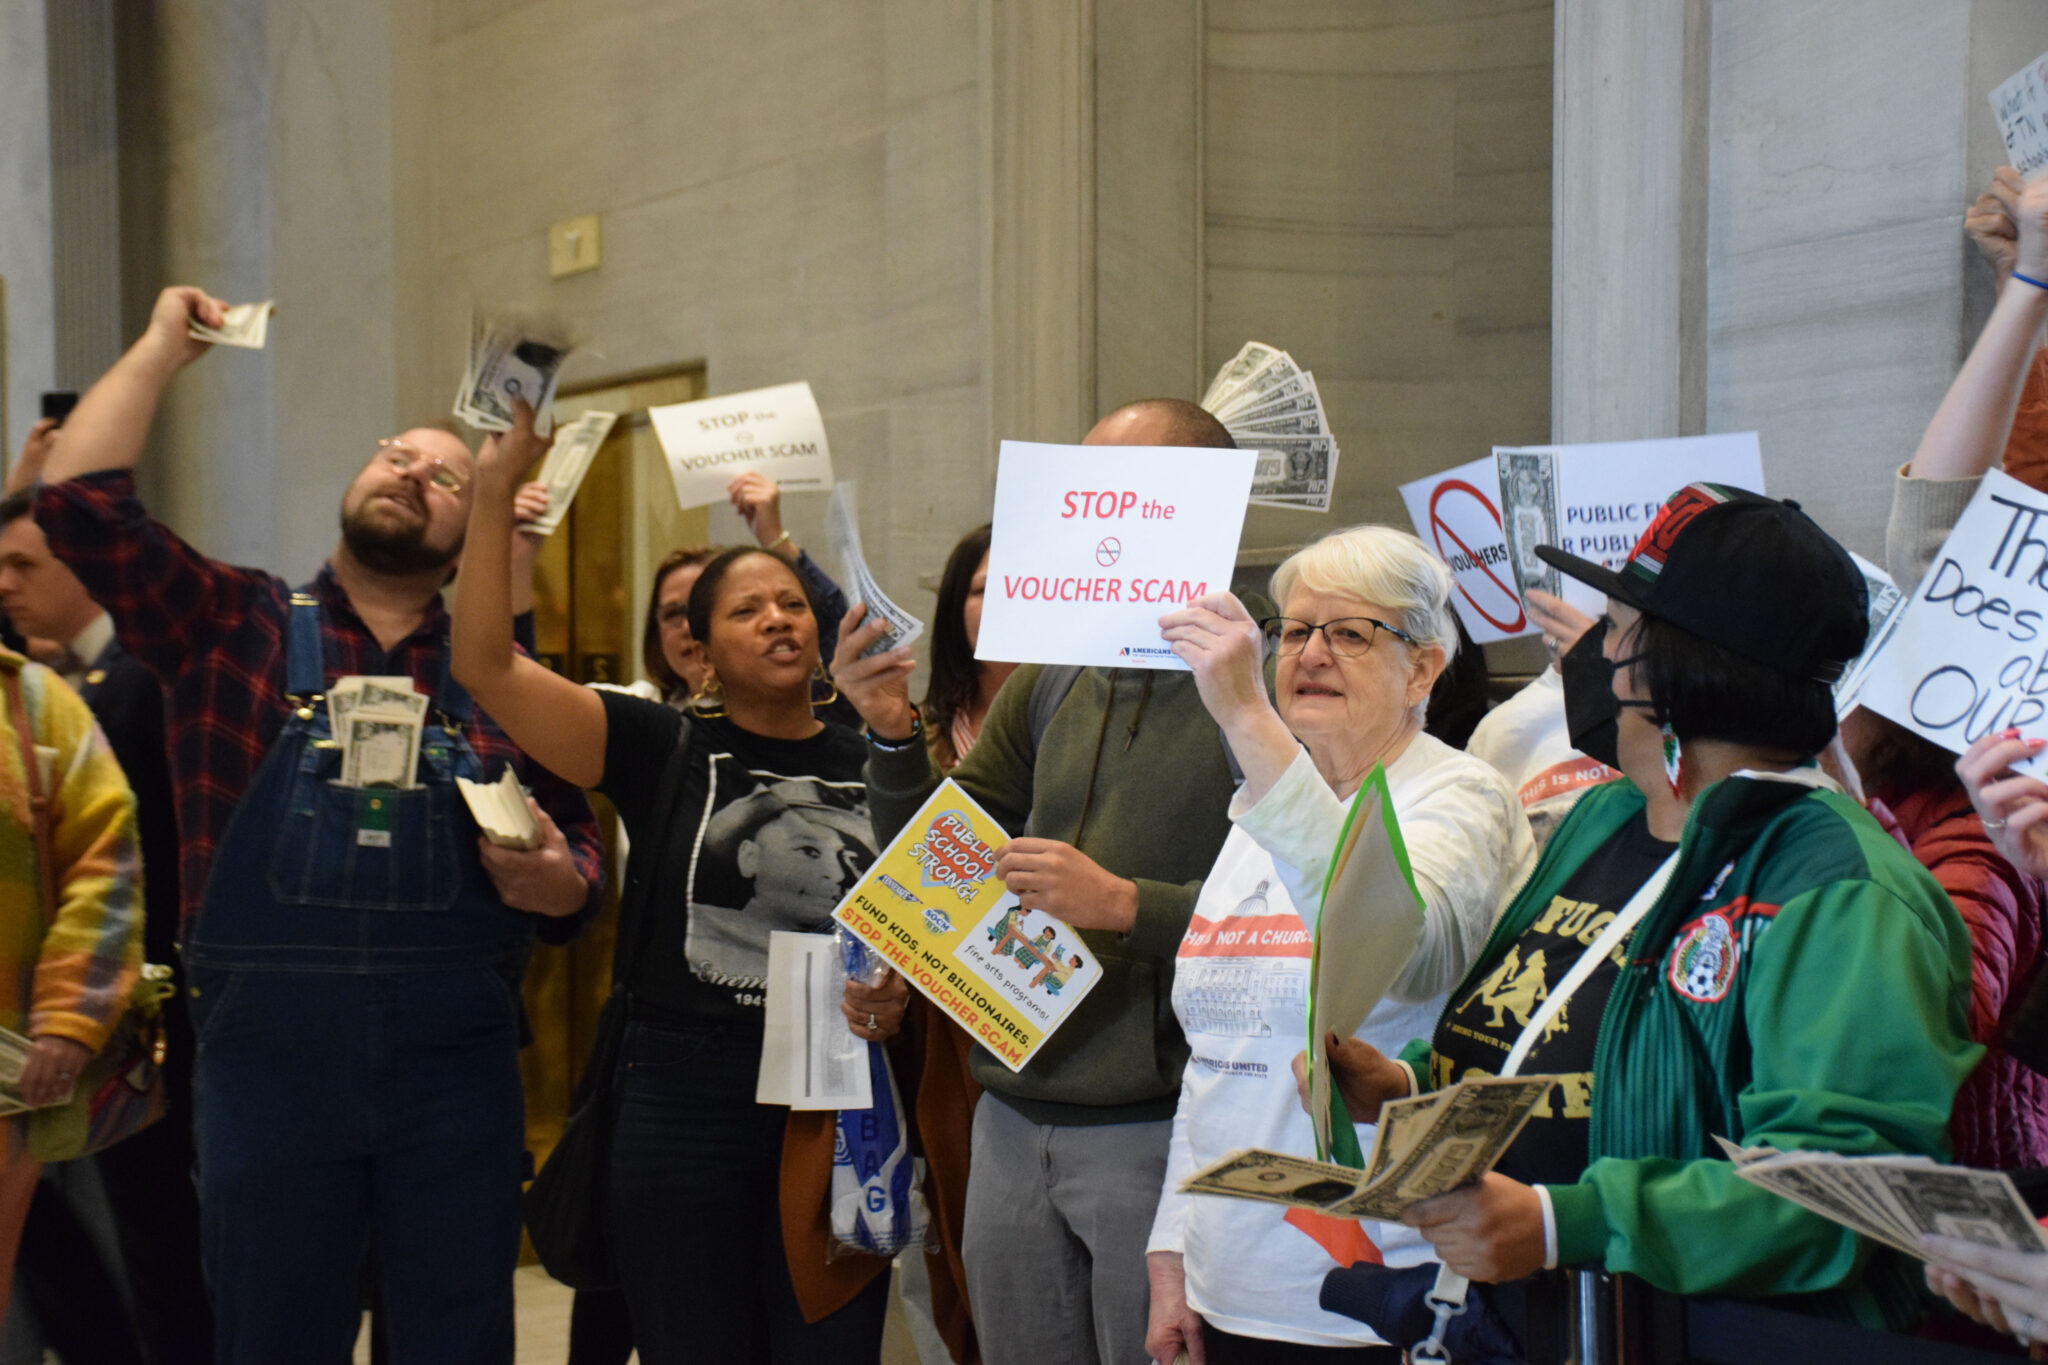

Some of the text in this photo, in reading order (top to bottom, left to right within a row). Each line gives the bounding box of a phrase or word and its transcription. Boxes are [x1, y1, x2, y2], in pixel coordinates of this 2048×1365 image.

[698, 411, 750, 432] STOP
[681, 442, 819, 471] VOUCHER SCAM
[1061, 491, 1175, 520] STOP the
[1567, 503, 1638, 524] PUBLIC
[1580, 534, 1639, 553] PUBLI
[1004, 575, 1207, 603] VOUCHER SCAM
[1924, 558, 2042, 642] Does
[1523, 764, 1610, 802] HIS IS NOT
[940, 815, 995, 864] PUBLIC
[925, 829, 985, 884] SCHOOL
[908, 843, 979, 904] STRONG!
[926, 909, 950, 931] SOCM
[1216, 931, 1246, 945] NOT
[1247, 931, 1259, 945] A
[842, 907, 883, 943] STOP
[882, 941, 909, 967] THE
[911, 963, 979, 1027] VOUCHER
[855, 895, 888, 925] FUND
[921, 950, 949, 976] NOT
[947, 973, 1029, 1048] BILLIONAIRES.
[964, 945, 1050, 1021] fine arts programs!
[1232, 1062, 1268, 1073] UNITED
